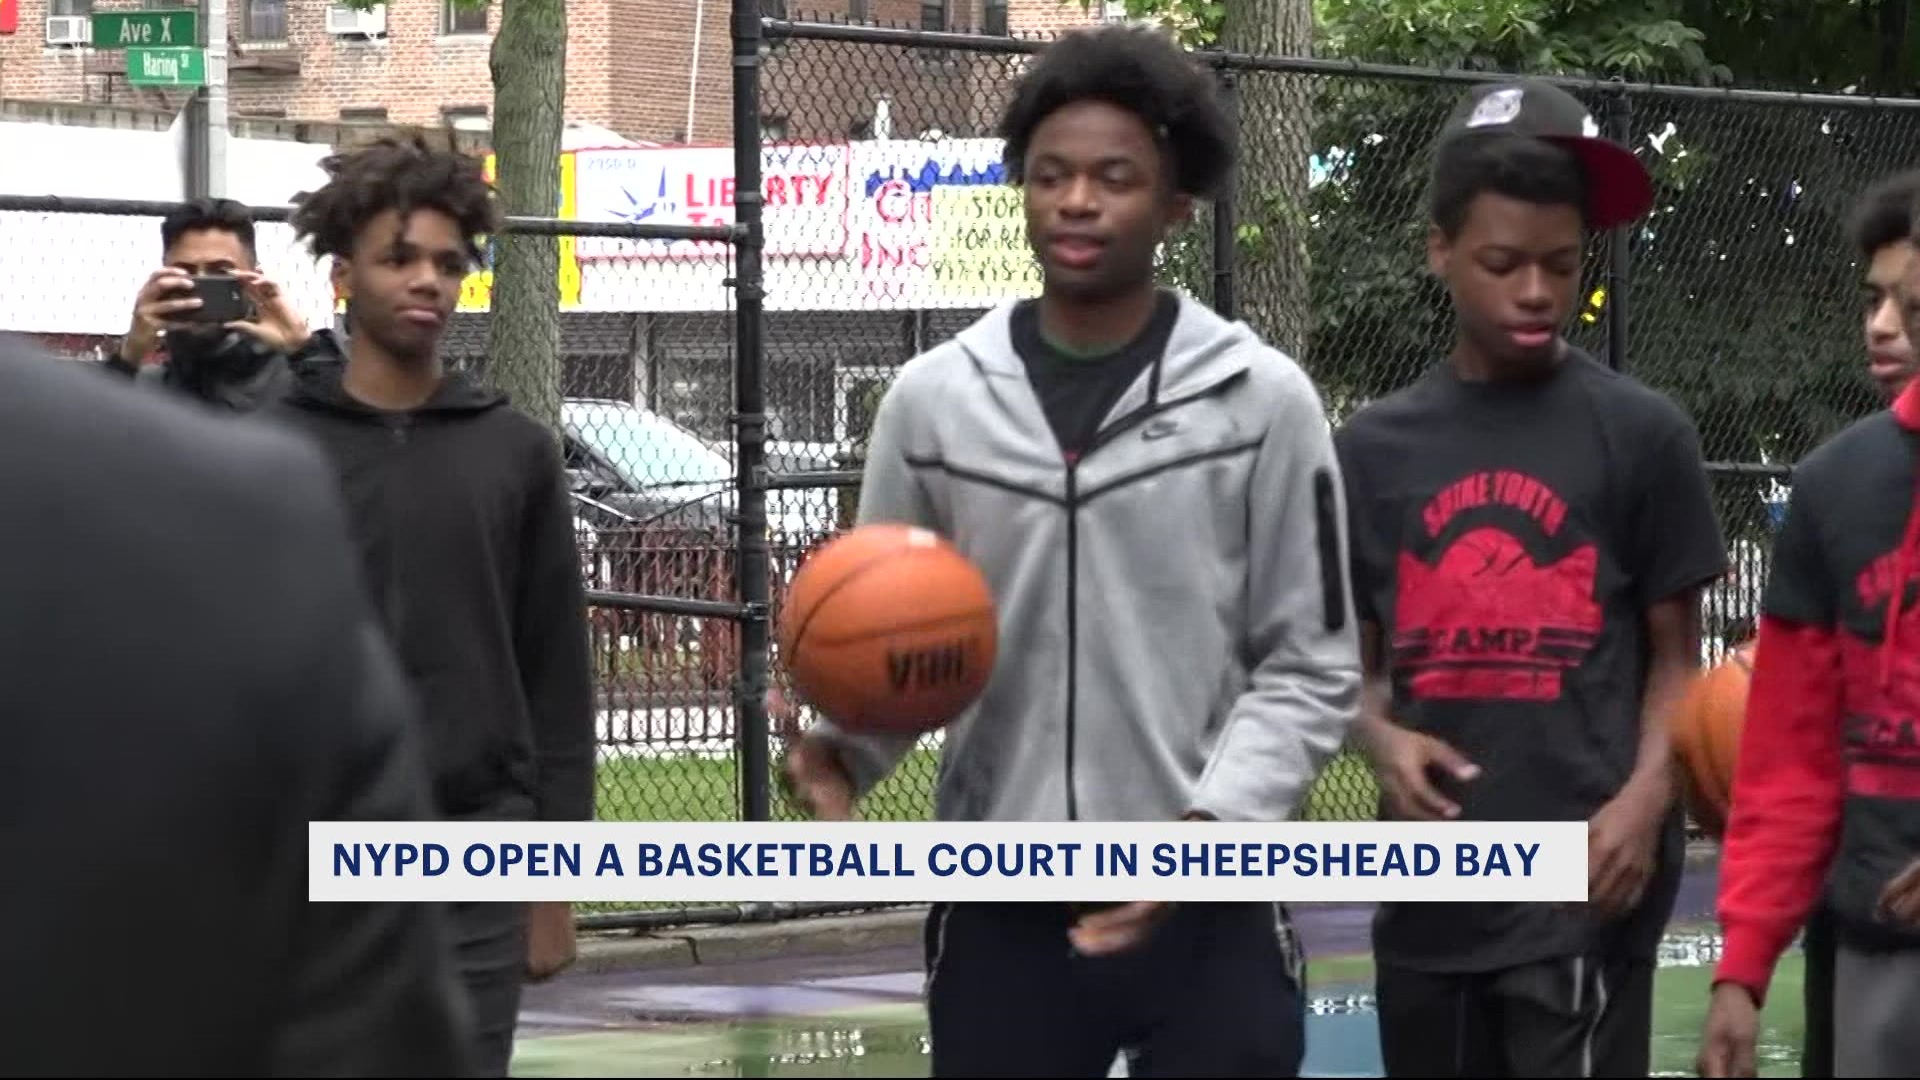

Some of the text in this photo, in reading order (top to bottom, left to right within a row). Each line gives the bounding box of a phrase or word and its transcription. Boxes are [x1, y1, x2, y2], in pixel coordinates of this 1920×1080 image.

[119, 16, 172, 43] Ave X
[143, 52, 178, 83] Haring
[686, 172, 834, 207] LIBRTY
